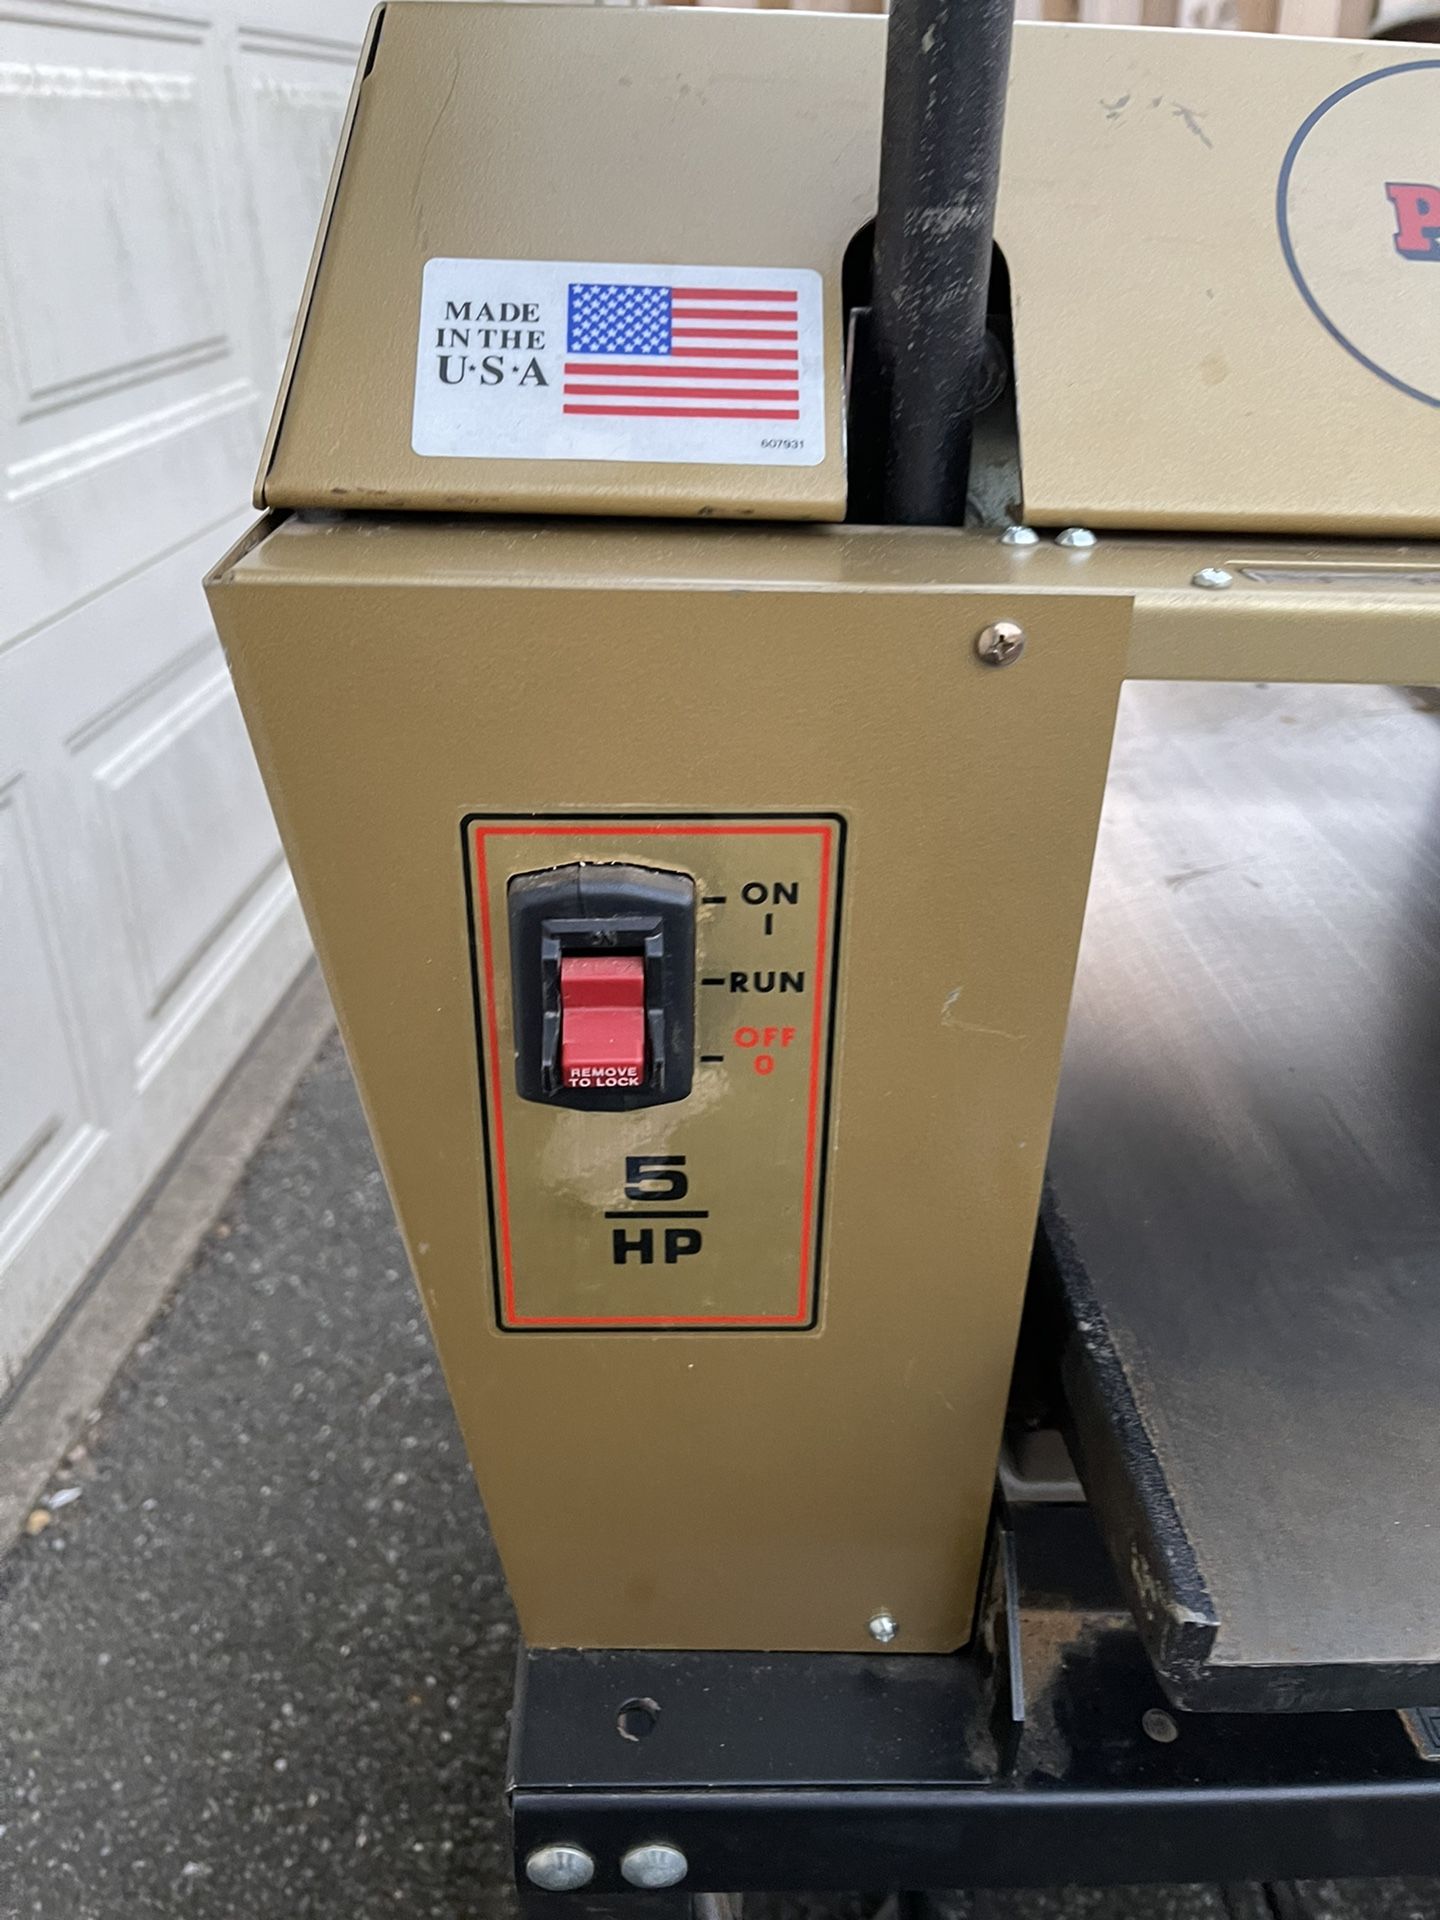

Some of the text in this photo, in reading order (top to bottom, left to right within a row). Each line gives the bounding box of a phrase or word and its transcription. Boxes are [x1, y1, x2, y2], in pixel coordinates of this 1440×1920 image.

[445, 301, 540, 322] MADE
[435, 328, 546, 350] IN THE
[761, 439, 804, 449] 607931
[741, 882, 798, 905] ON
[730, 971, 804, 993] RUN
[733, 1026, 796, 1048] OFF
[568, 1077, 639, 1087] TO LOCK
[570, 1067, 637, 1077] REMOVE
[624, 1155, 688, 1201] 5
[613, 1229, 702, 1264] HP
